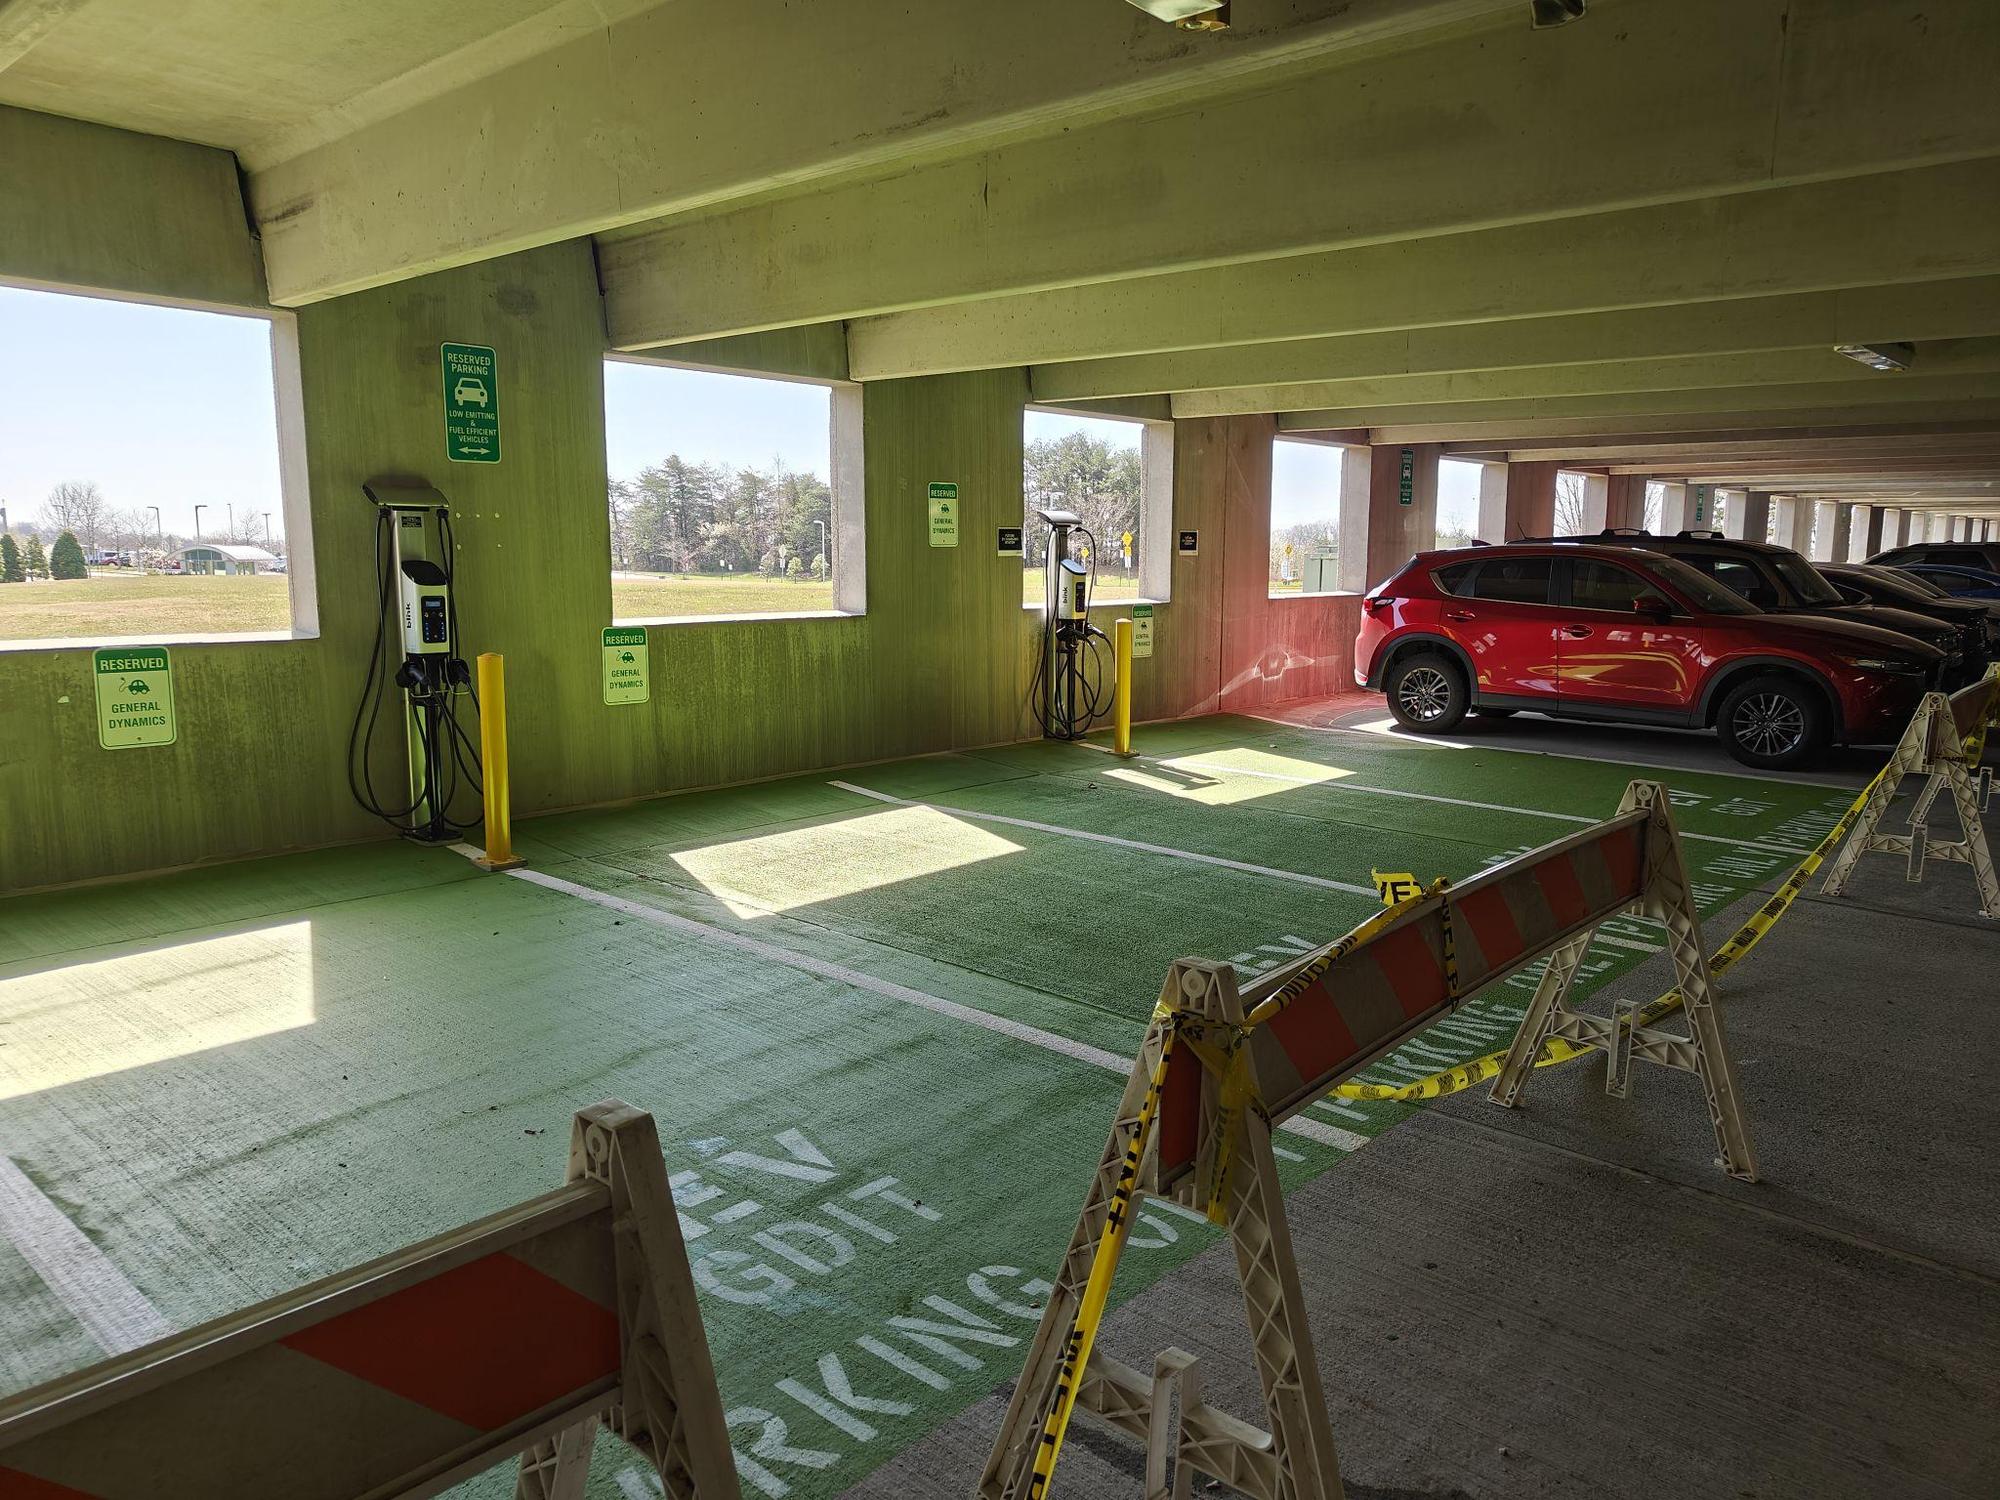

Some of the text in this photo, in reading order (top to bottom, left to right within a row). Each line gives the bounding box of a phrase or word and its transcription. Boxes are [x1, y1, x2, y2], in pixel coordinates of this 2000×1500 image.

[447, 352, 491, 366] RESERVED
[451, 363, 488, 376] PARKING
[449, 410, 496, 421] LOW EMITTING
[449, 426, 497, 436] FUEL EFFICIENT
[458, 435, 489, 444] VEHICLES
[606, 635, 644, 645] RESERVED
[100, 657, 164, 671] RESERVED
[611, 669, 640, 678] GENERAL
[609, 680, 644, 689] DYNAMICS
[111, 702, 161, 714] GENERAL
[109, 716, 166, 729] DYNAMICS
[667, 1127, 842, 1241] EV
[692, 1175, 945, 1305] GDIT
[615, 1264, 1052, 1500] RKING
